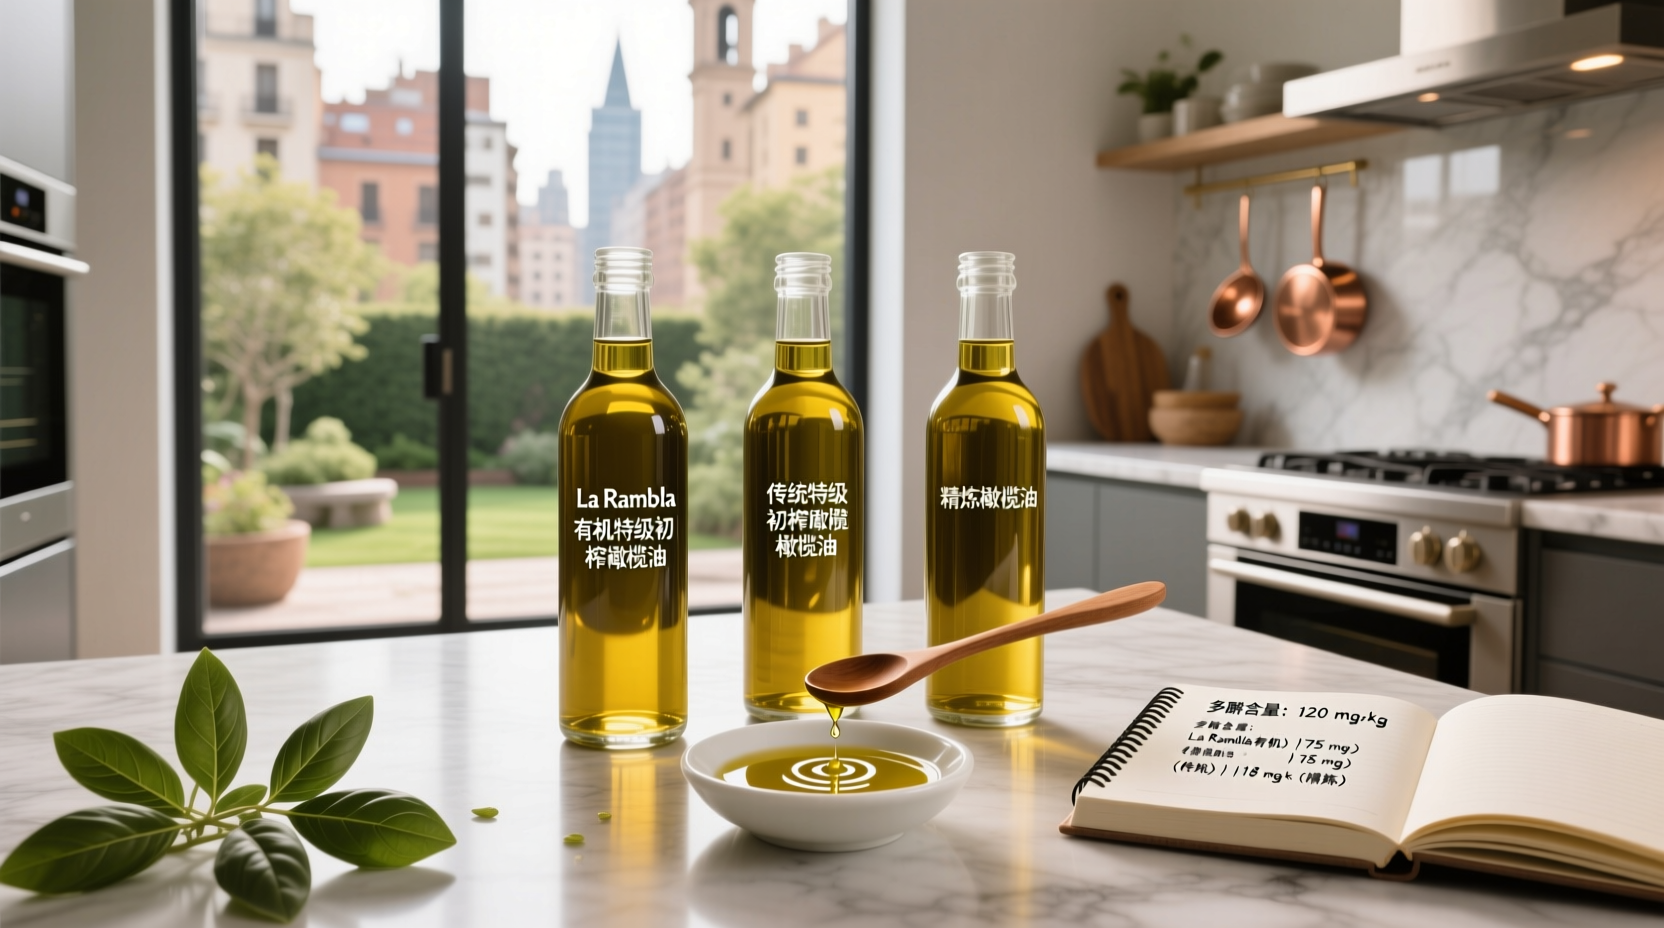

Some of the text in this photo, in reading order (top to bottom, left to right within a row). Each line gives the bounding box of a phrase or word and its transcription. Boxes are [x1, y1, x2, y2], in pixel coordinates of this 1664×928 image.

[577, 486, 676, 508] La Rambla
[766, 481, 848, 505] 传统特级
[940, 485, 1037, 510] 精炼橄榄油
[574, 516, 674, 541] 有机特级初
[585, 544, 667, 570] 榨橄榄油
[775, 533, 837, 559] 橄榄油
[1299, 706, 1329, 719] 120
